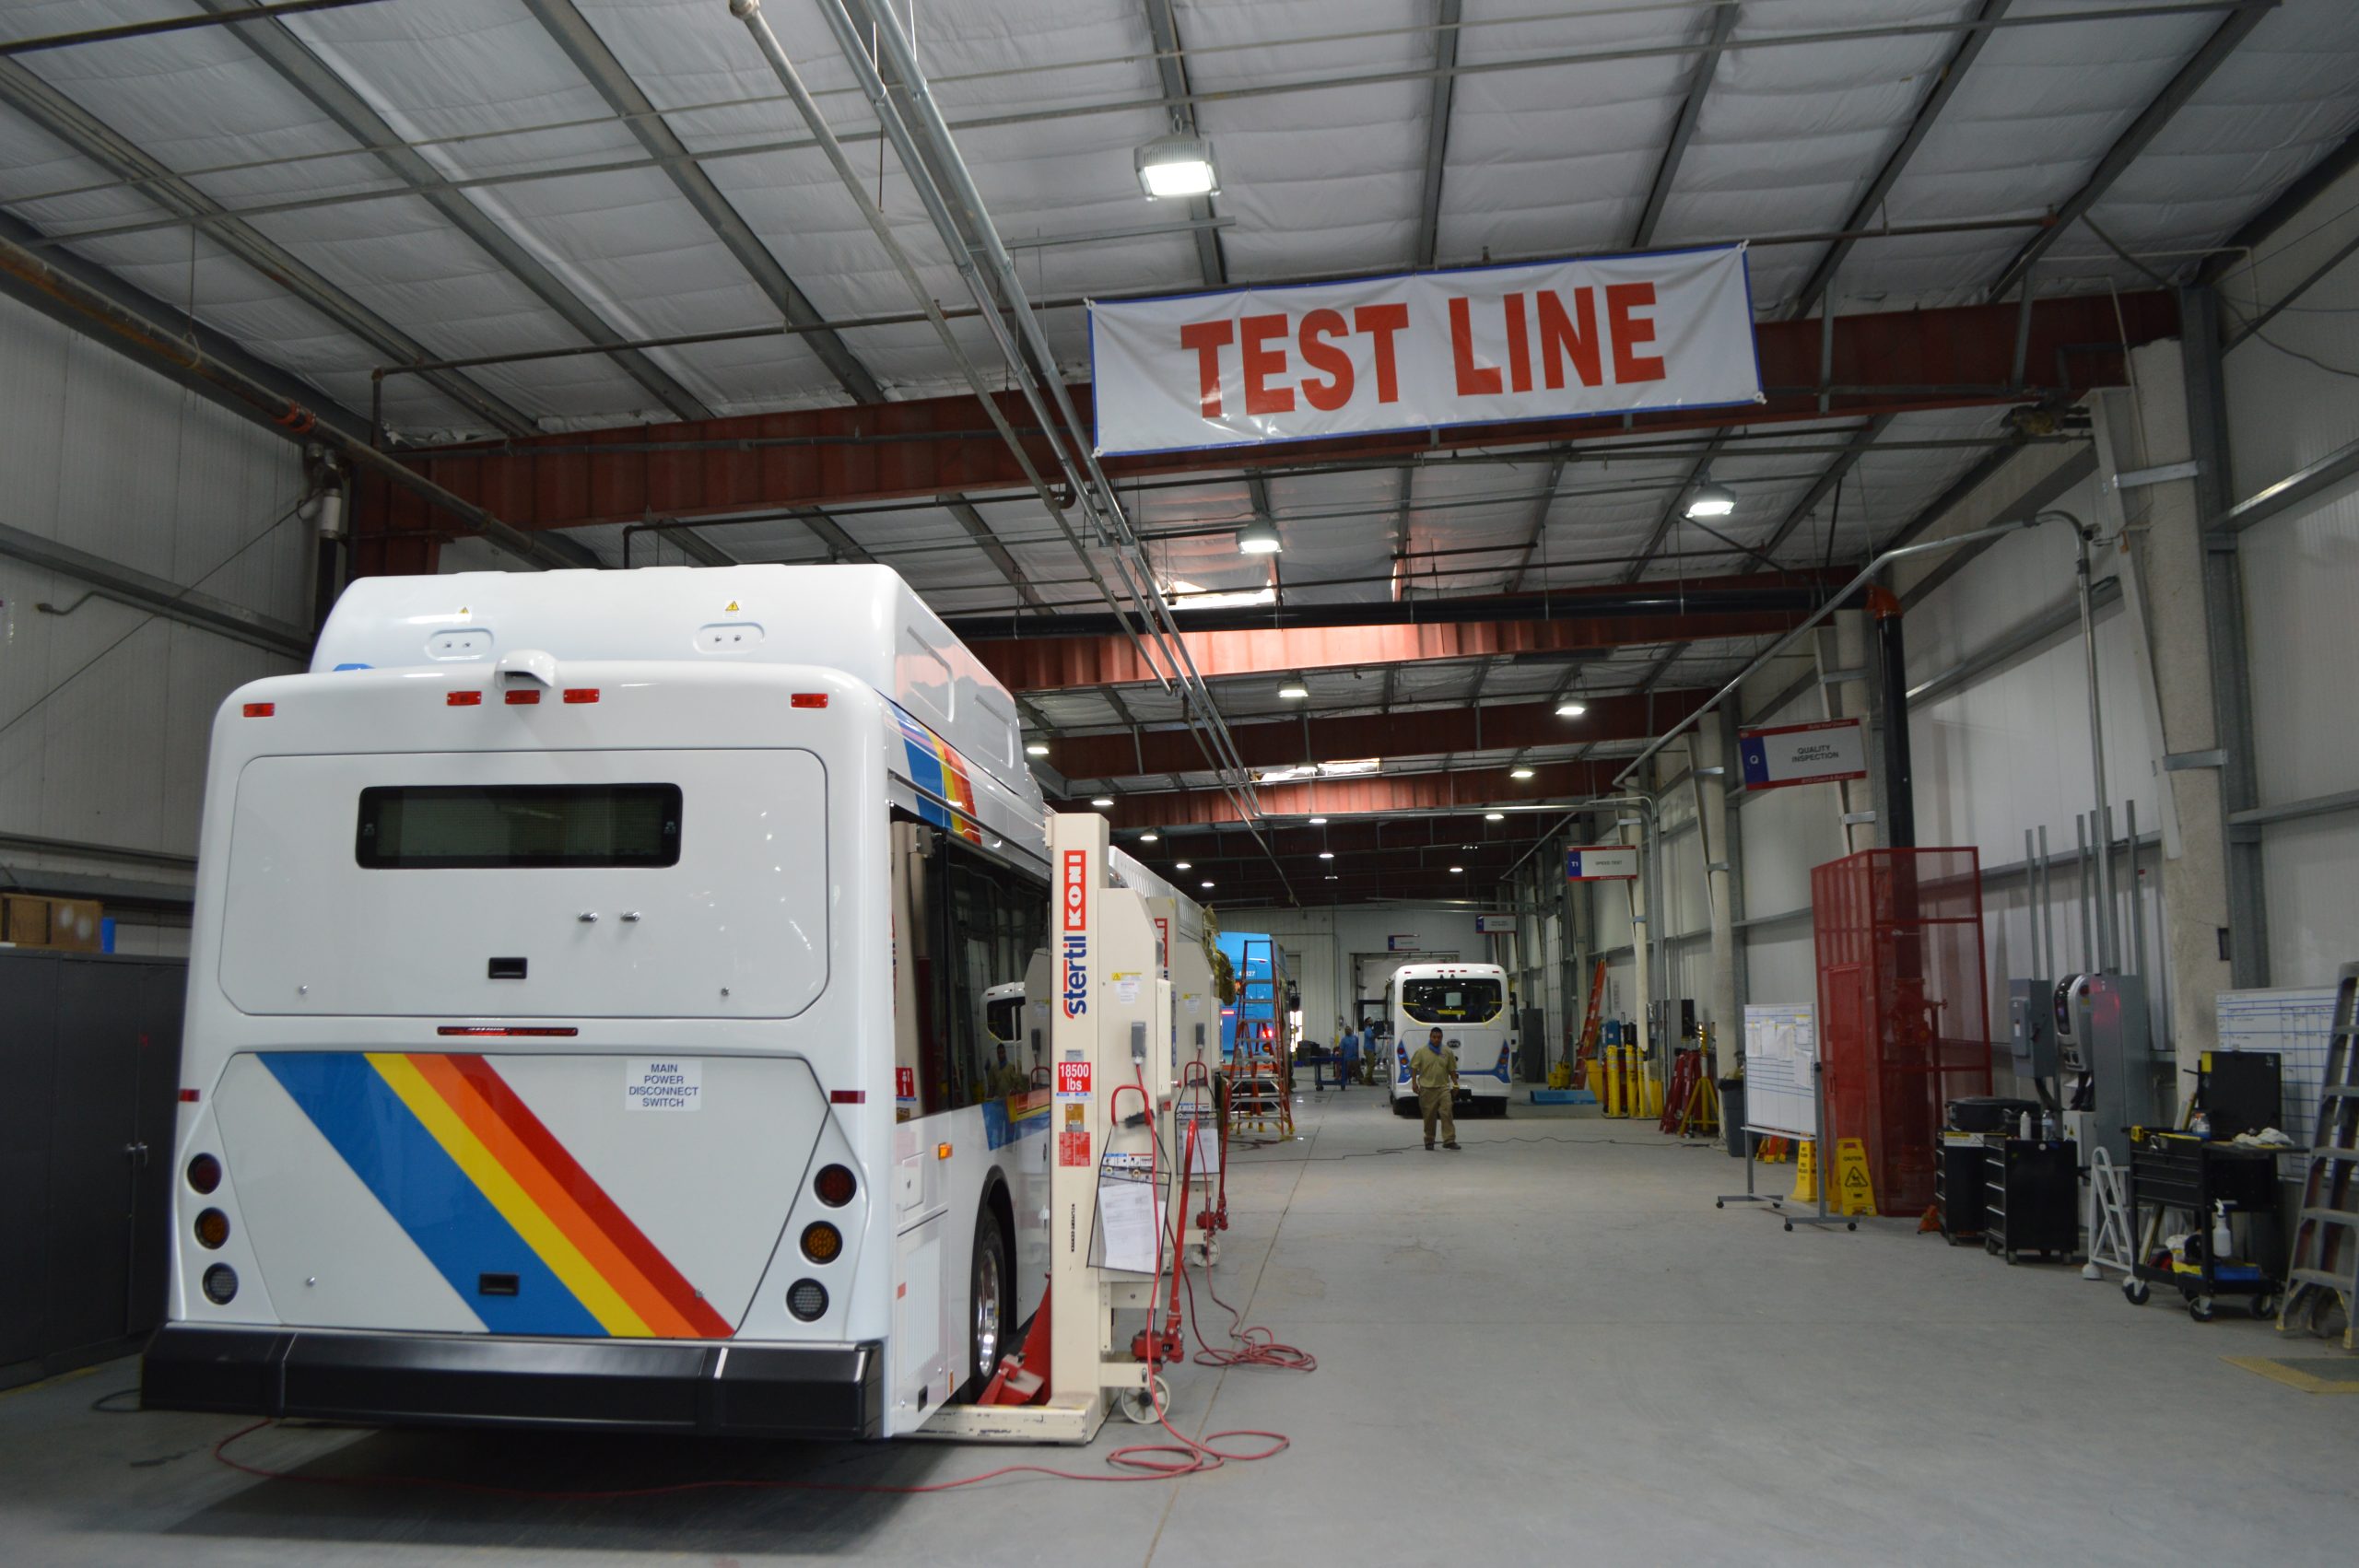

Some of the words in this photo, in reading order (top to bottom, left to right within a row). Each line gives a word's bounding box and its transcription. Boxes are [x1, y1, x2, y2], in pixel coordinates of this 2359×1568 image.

[1180, 302, 1410, 419] TEST
[1449, 281, 1666, 397] LINE
[1797, 744, 1831, 755] QUALITY
[1749, 755, 1759, 765] Q
[1791, 751, 1839, 763] INSPECTION
[1067, 855, 1083, 927] KONI
[1063, 935, 1086, 1019] stertil
[651, 1063, 678, 1073] MAIN
[1060, 1064, 1089, 1078] 18500
[644, 1075, 685, 1084] POWER
[1066, 1078, 1083, 1091] lbs
[628, 1086, 699, 1096] DISCONNECT
[642, 1097, 685, 1107] SWITCH
